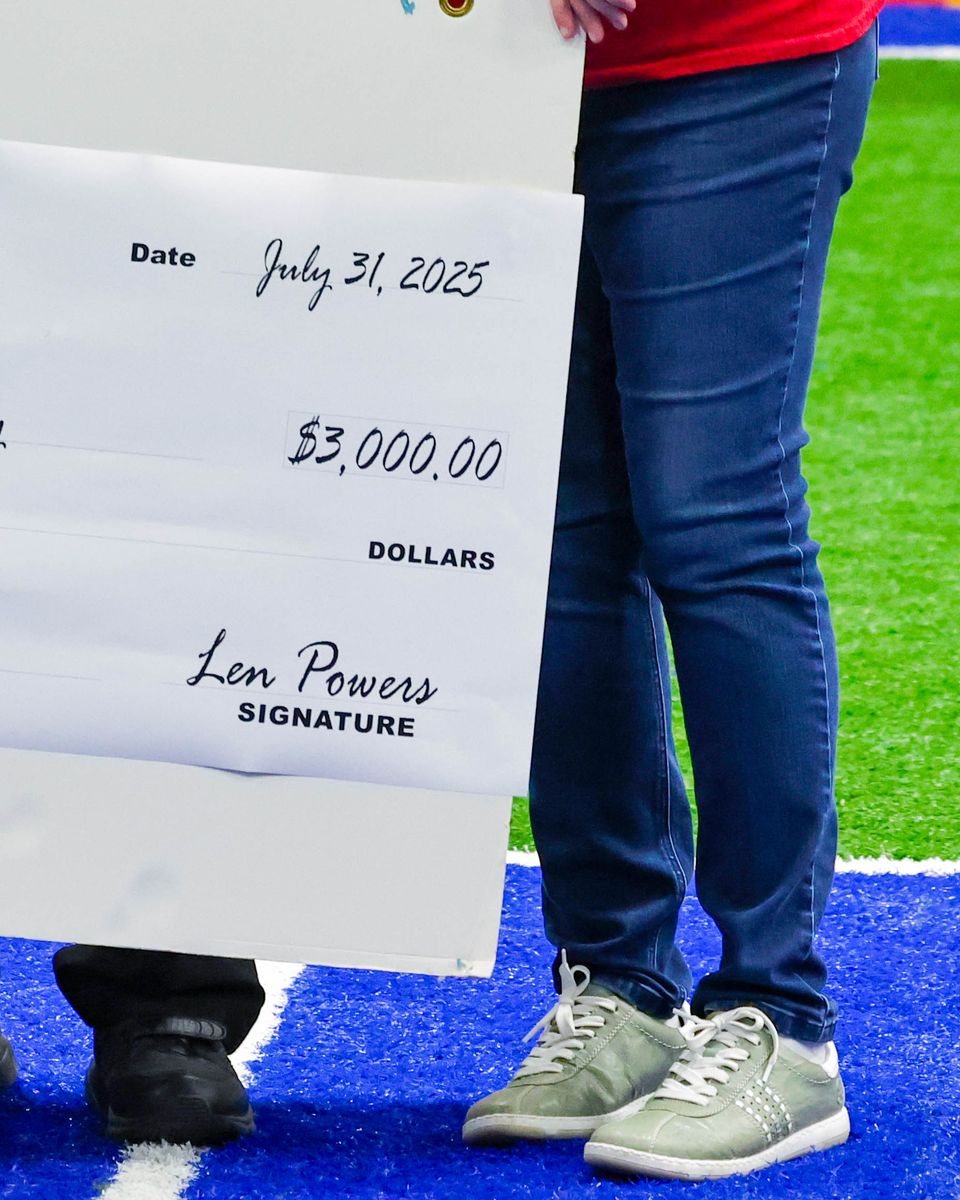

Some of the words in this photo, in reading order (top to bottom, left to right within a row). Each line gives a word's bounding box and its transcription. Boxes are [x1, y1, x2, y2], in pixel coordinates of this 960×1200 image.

[130, 242, 196, 268] Date
[255, 238, 333, 312] July
[344, 251, 386, 297] 31,
[399, 256, 490, 298] 2025
[287, 414, 503, 482] $3,000.00
[368, 540, 496, 571] DOLLARS
[186, 628, 277, 688] Len
[297, 640, 439, 706] Powers
[237, 701, 416, 738] SIGNATURE
